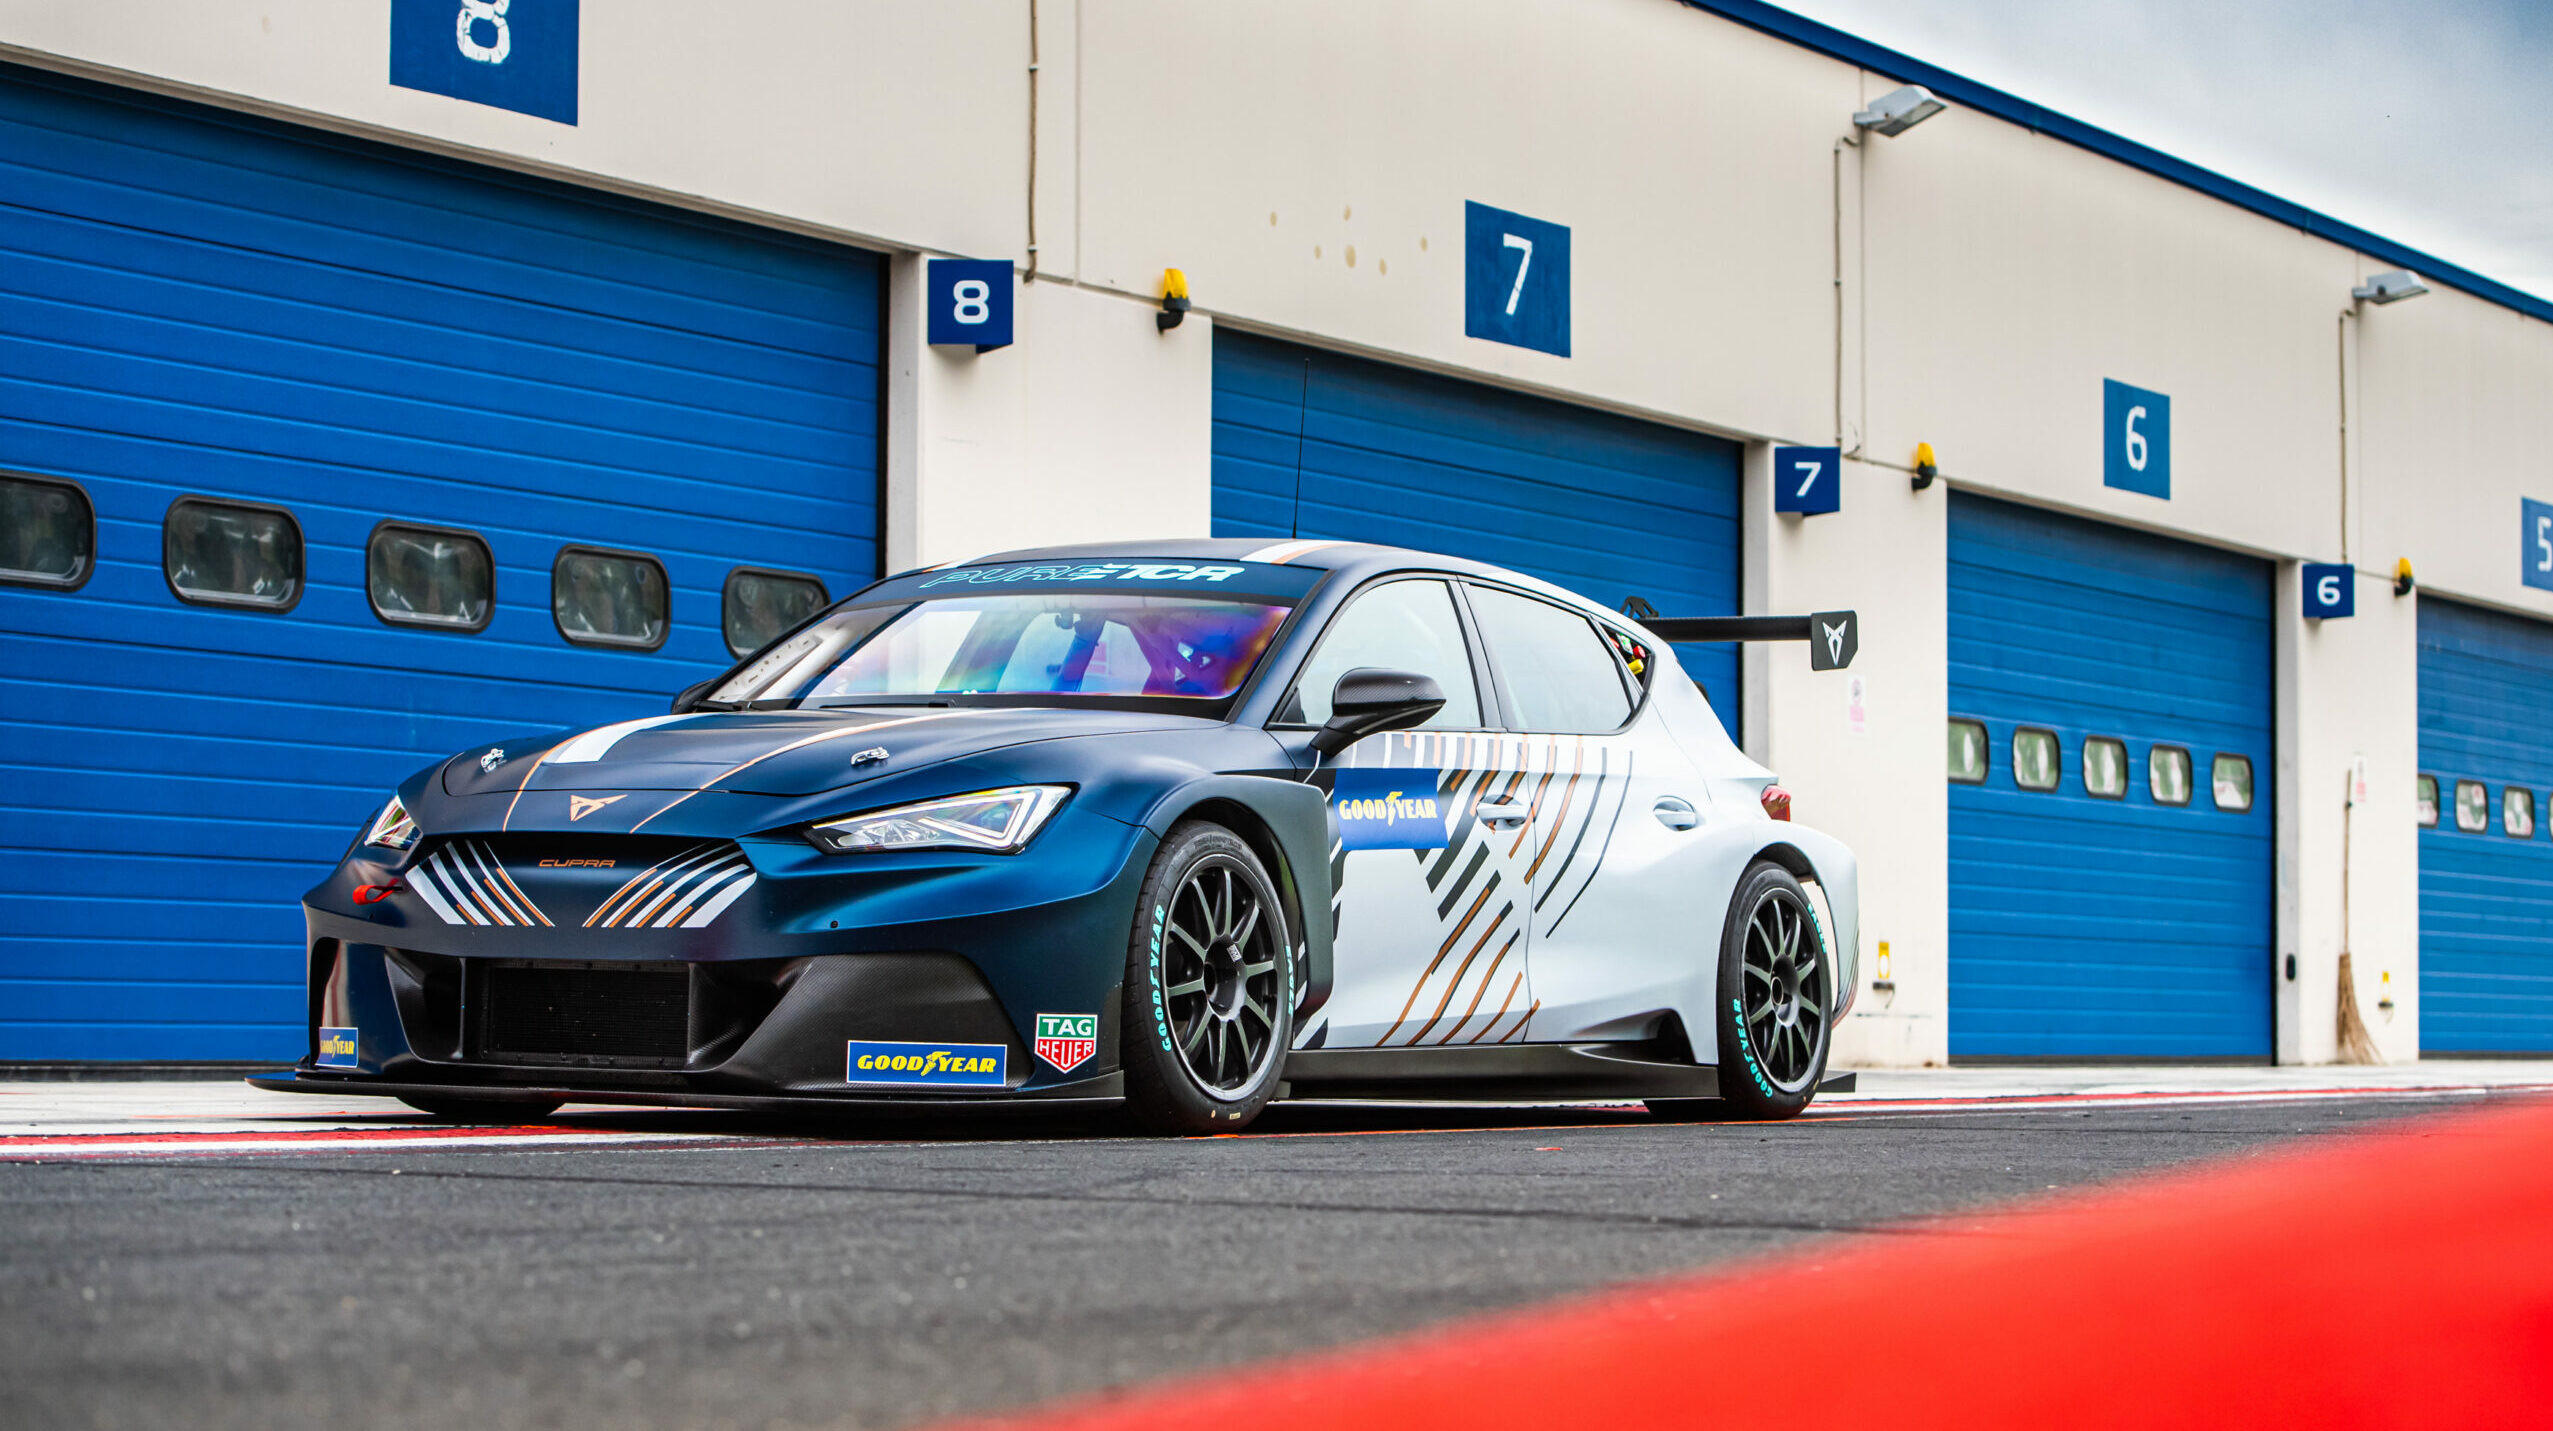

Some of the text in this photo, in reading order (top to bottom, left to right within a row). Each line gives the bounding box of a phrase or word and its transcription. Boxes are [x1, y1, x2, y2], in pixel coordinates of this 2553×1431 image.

[456, 0, 511, 64] 8
[1503, 233, 1534, 316] 7
[953, 279, 990, 325] 8
[2125, 405, 2148, 471] 6
[1795, 460, 1822, 497] 7
[2537, 515, 2553, 572] 5
[2317, 575, 2341, 606] 6
[1338, 791, 1438, 827] GOODYEAR
[538, 858, 617, 869] CUPRA
[1149, 904, 1172, 1052] GOODYEAR
[1042, 1018, 1092, 1036] TAG
[857, 1051, 997, 1077] GOODYEAR
[1039, 1040, 1093, 1068] HEUER
